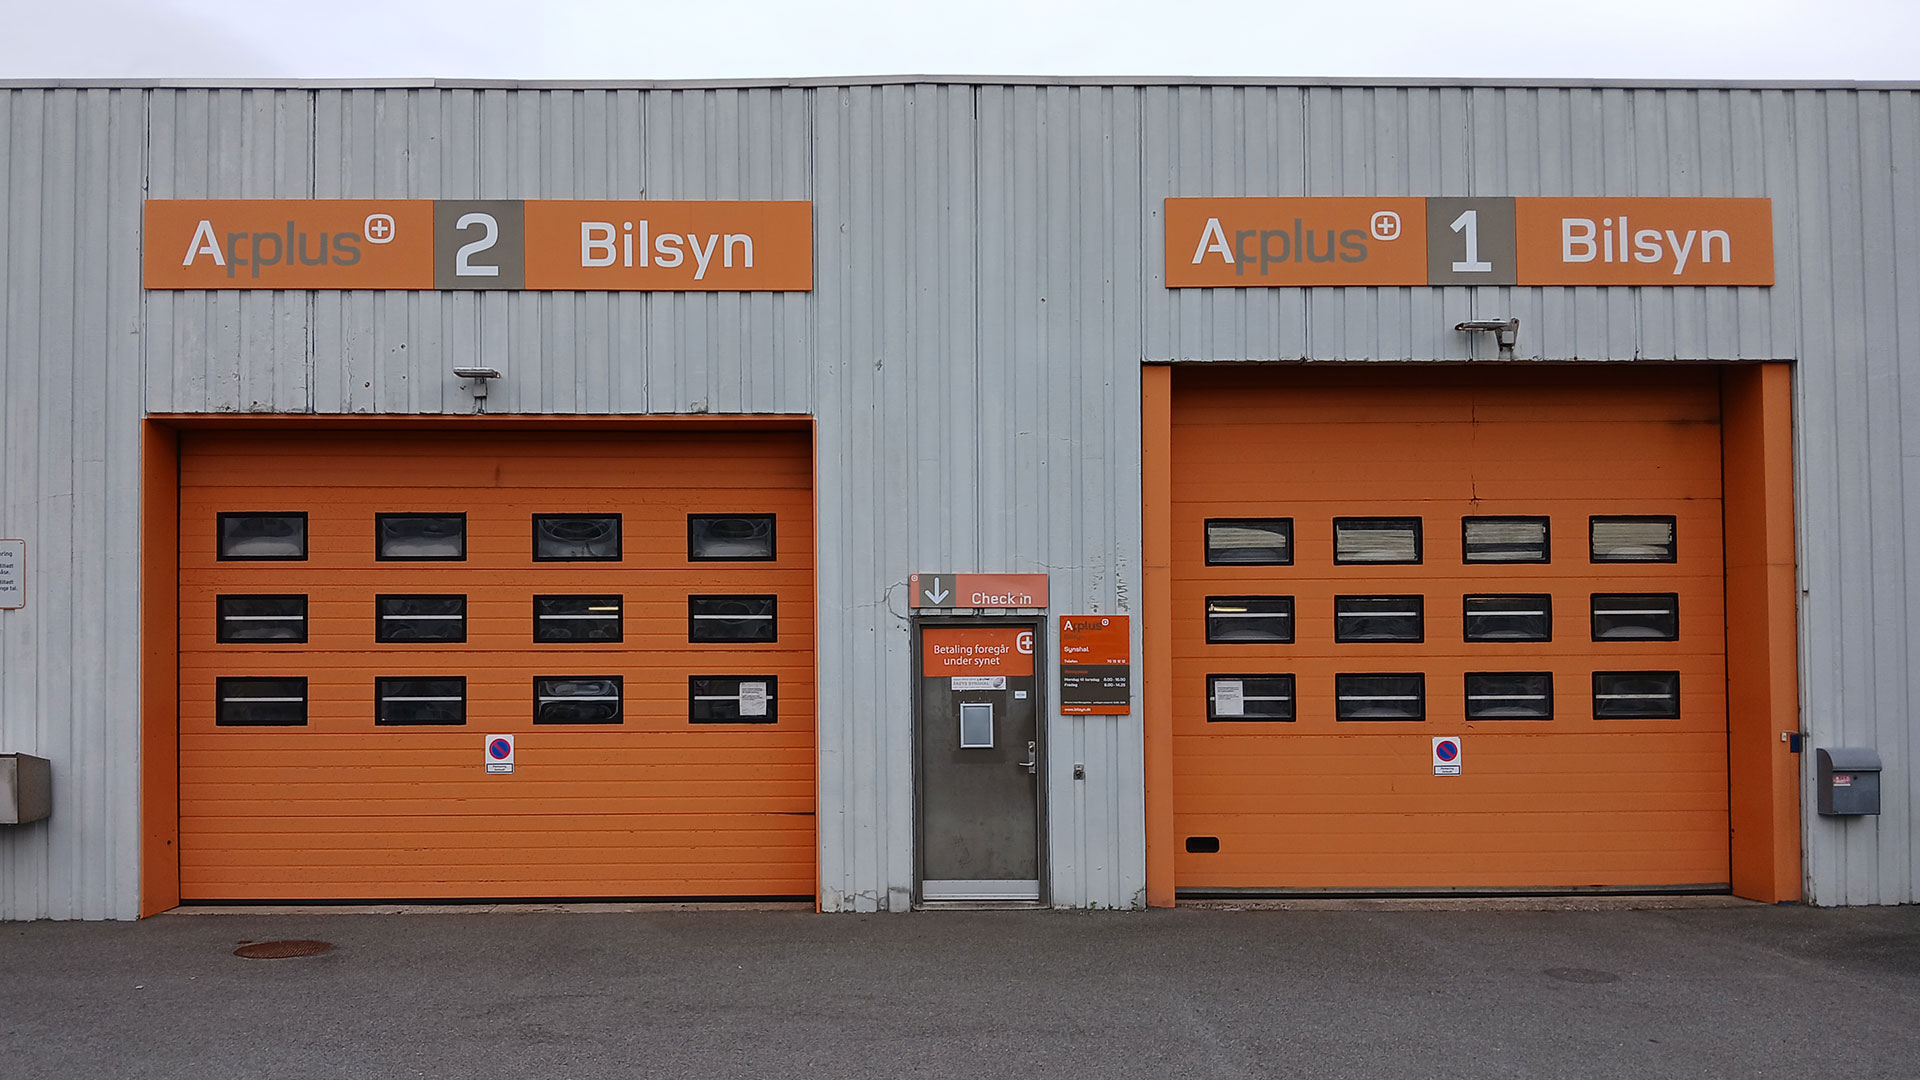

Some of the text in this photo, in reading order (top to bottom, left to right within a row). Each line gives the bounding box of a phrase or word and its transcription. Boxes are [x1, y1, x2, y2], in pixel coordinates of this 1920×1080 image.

[455, 212, 499, 276] 2
[581, 220, 753, 280] Bilsyn
[1449, 210, 1492, 272] 1
[1562, 216, 1731, 275] Bilsyn
[971, 592, 1032, 604] Check in
[933, 644, 1010, 655] Betaling foregår
[943, 656, 1000, 667] under synet
